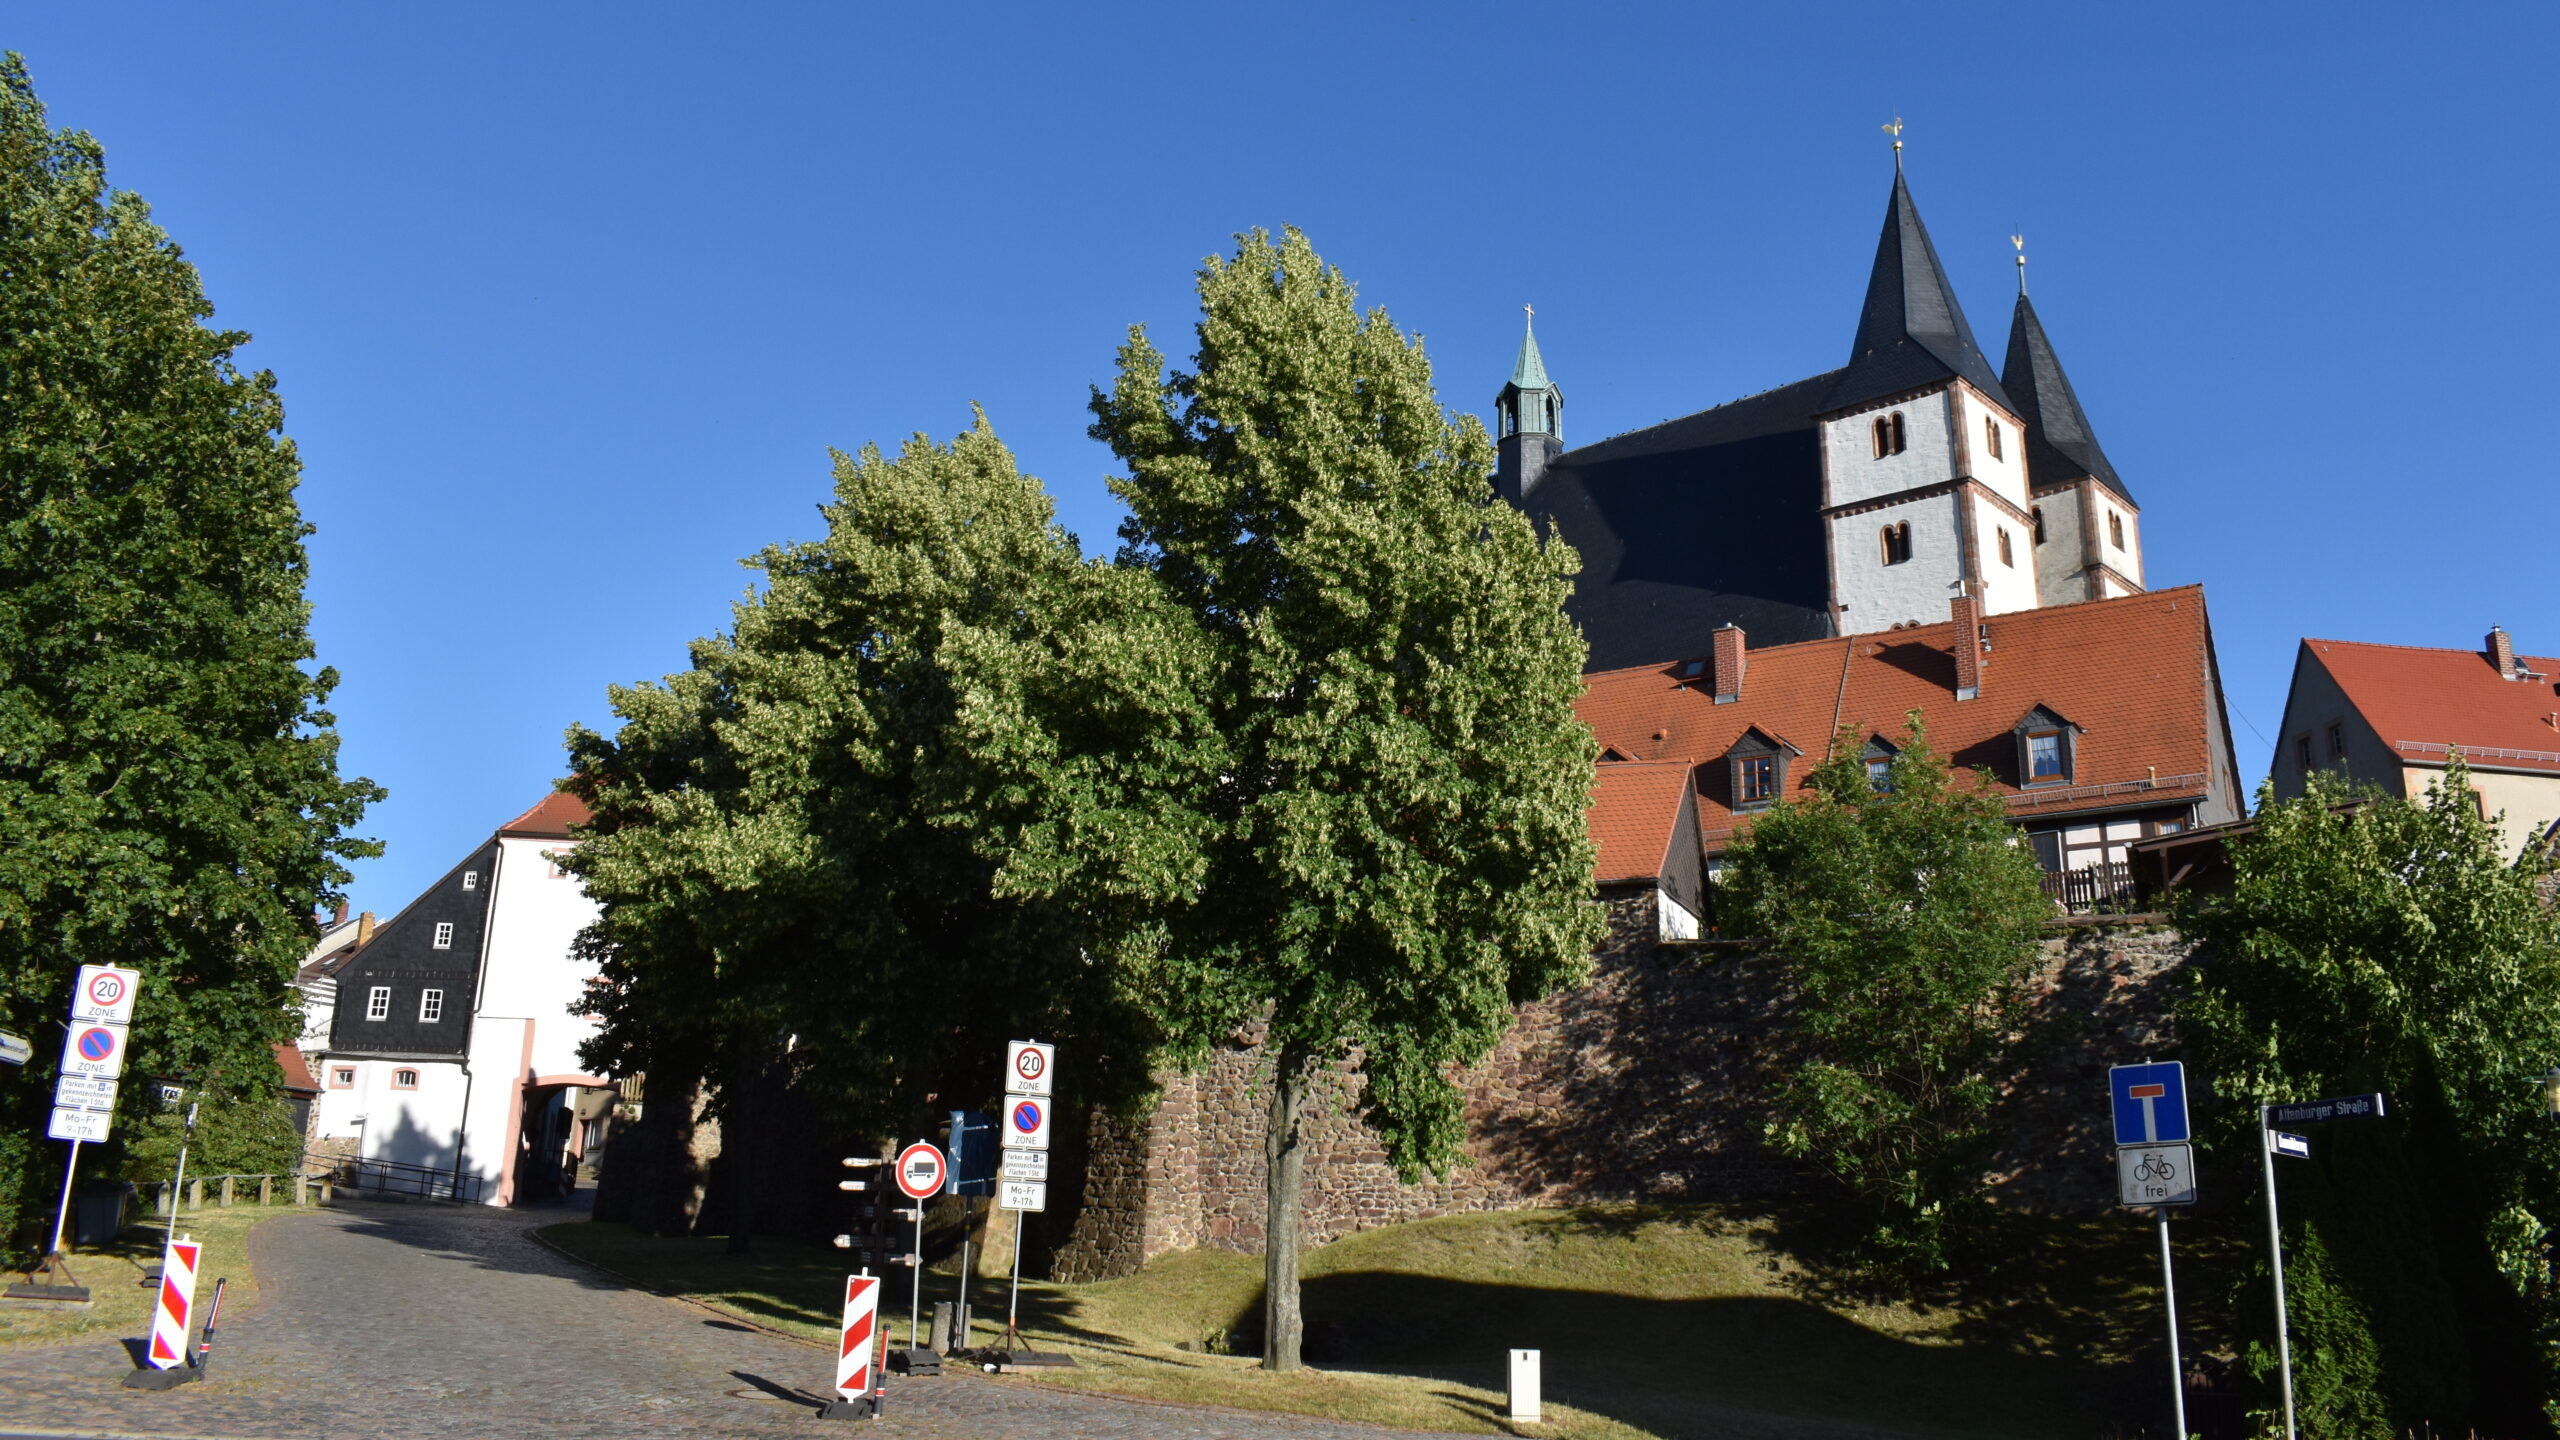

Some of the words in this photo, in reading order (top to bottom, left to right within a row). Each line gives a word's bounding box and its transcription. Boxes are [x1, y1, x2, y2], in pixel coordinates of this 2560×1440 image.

[96, 981, 118, 998] 20
[88, 1007, 117, 1018] ZONE
[77, 1062, 106, 1073] ZONE
[1022, 1055, 1040, 1072] 20
[65, 1080, 85, 1088] Parken
[1018, 1081, 1040, 1091] ZONE
[65, 1095, 88, 1104] Flächen
[2278, 1105, 2333, 1121] Altenburger
[2335, 1099, 2369, 1116] Straße
[65, 1113, 102, 1124] Mo-Fr
[66, 1125, 93, 1136] 9-17h
[1015, 1135, 1038, 1145] ZONE
[1007, 1152, 1023, 1160] Parken
[1010, 1185, 1036, 1195] Mo-Fr
[2145, 1184, 2168, 1198] frei
[1012, 1196, 1033, 1206] 9-17h
